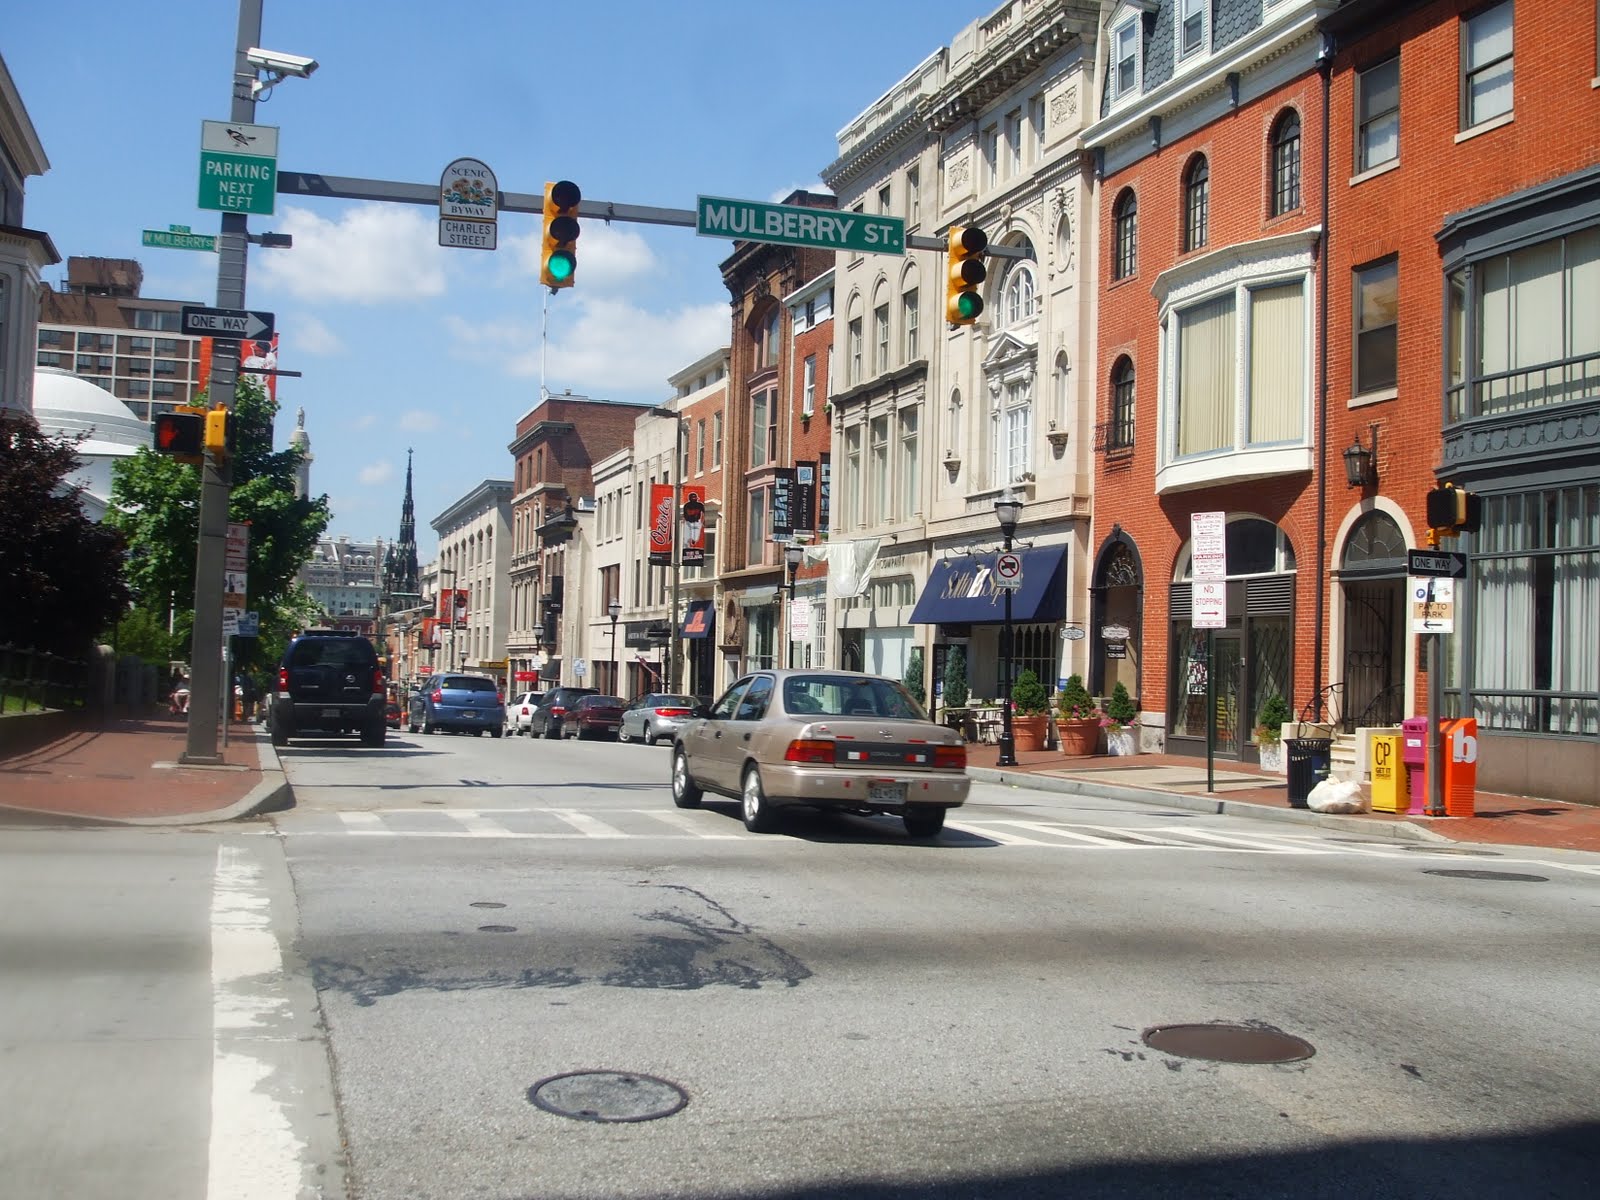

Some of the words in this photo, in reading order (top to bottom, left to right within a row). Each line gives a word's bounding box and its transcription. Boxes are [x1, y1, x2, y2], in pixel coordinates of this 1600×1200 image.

[206, 160, 270, 180] PARKING
[451, 168, 489, 178] SCENIC
[219, 181, 254, 194] NEXT
[219, 195, 252, 209] LEFT
[451, 205, 486, 216] BYWAY
[446, 222, 491, 235] CHARLES
[705, 204, 855, 243] MULBERRY
[864, 223, 899, 246] ST.
[143, 232, 151, 243] W
[154, 232, 207, 248] MULBERRY
[450, 234, 486, 246] STREET
[191, 315, 216, 328] ONE
[223, 317, 248, 331] WAY
[1415, 558, 1431, 568] ONE
[1435, 559, 1451, 570] WAY
[1204, 585, 1214, 593] NO
[1195, 597, 1222, 605] STOPPING
[1375, 742, 1391, 766] CP
